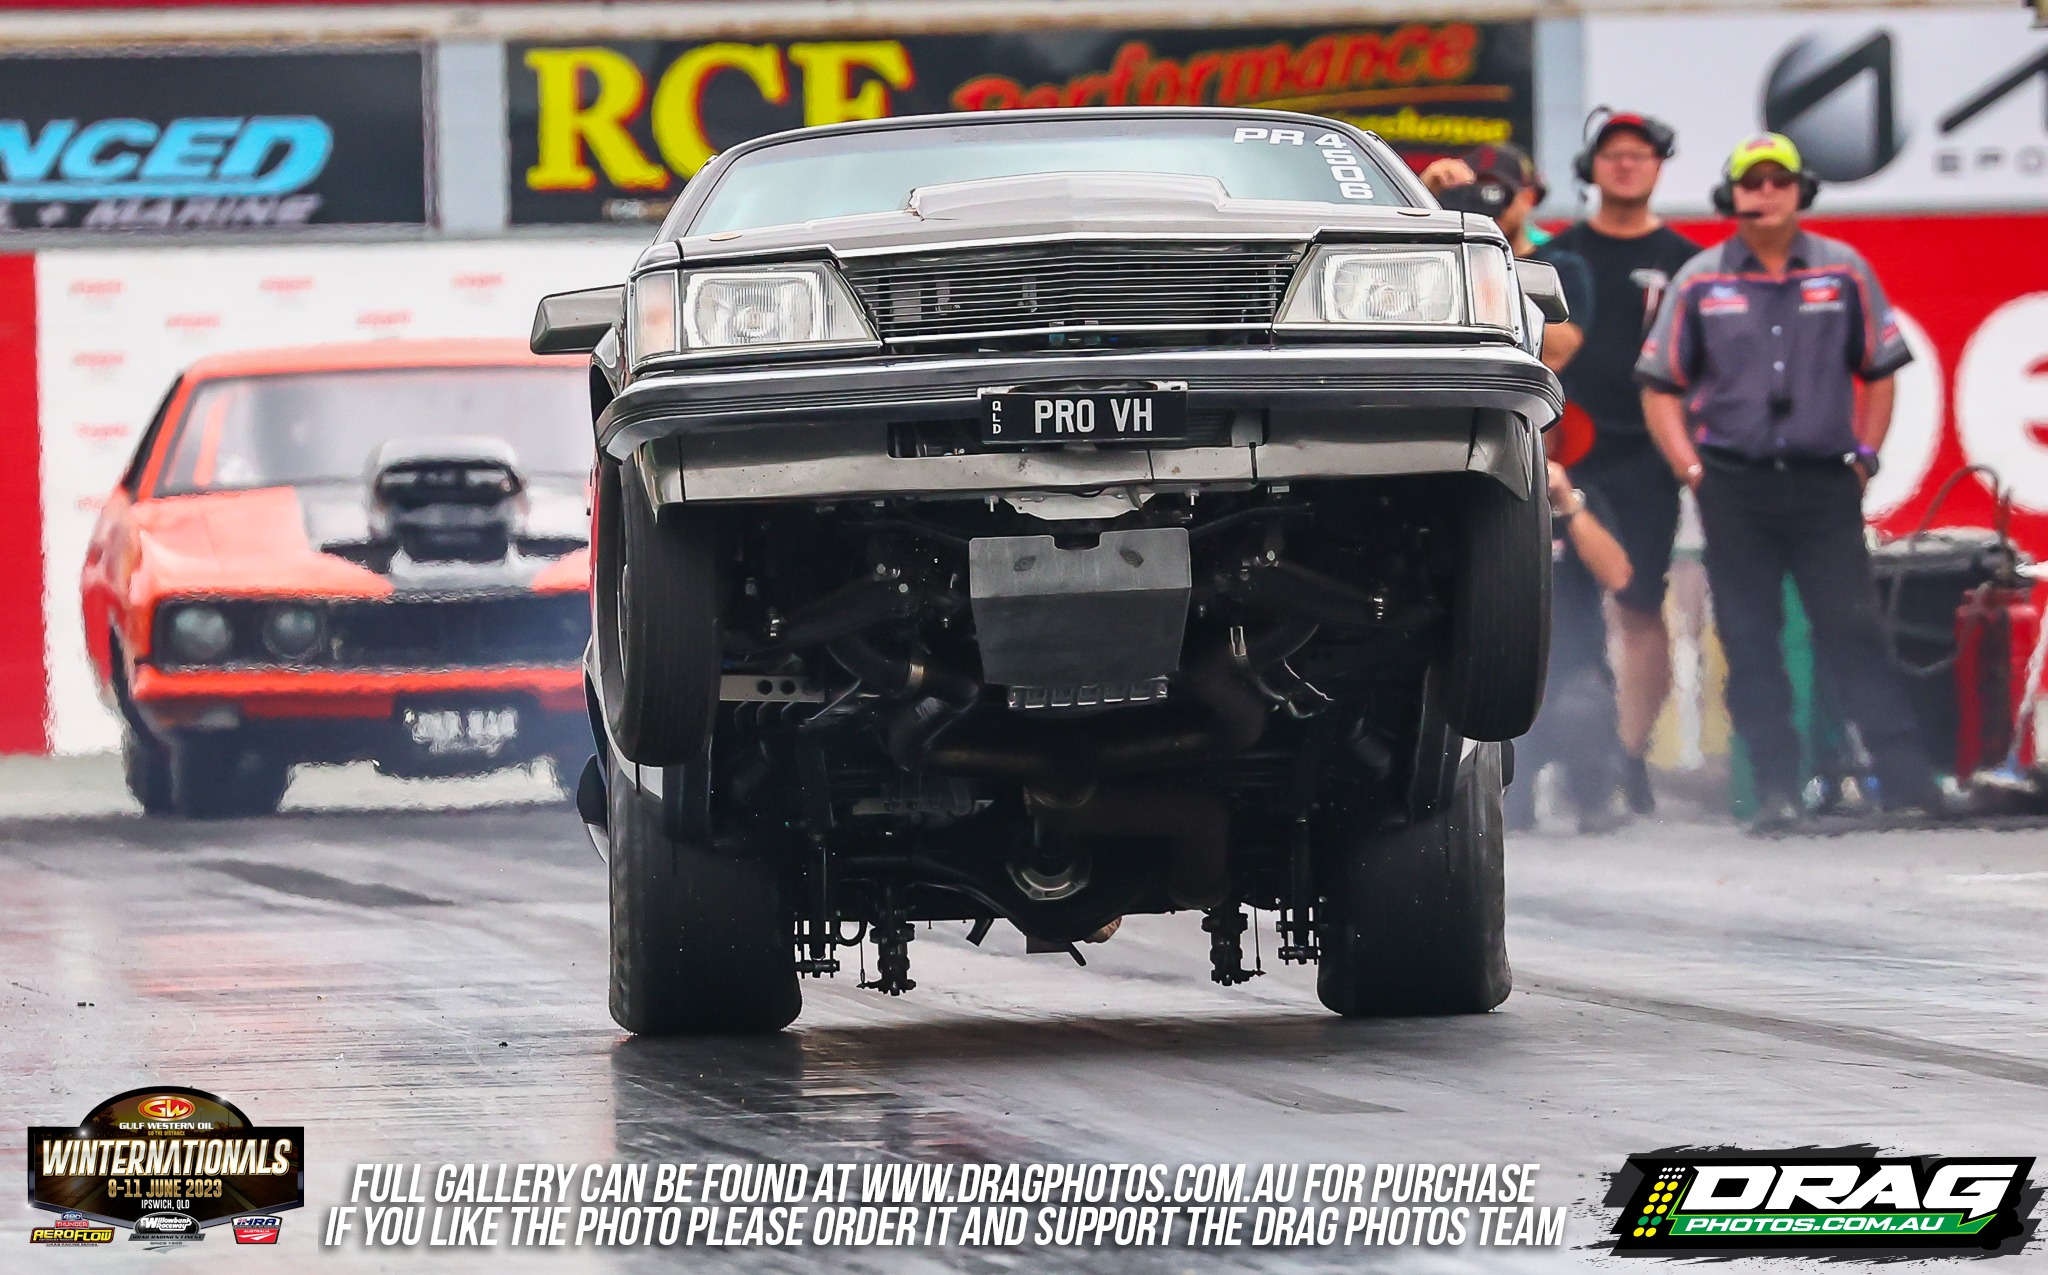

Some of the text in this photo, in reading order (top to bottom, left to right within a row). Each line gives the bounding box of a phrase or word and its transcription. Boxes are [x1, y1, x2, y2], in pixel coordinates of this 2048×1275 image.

[1233, 127, 1305, 146] PR
[991, 400, 1002, 435] QLD
[1034, 398, 1153, 434] PRO VH
